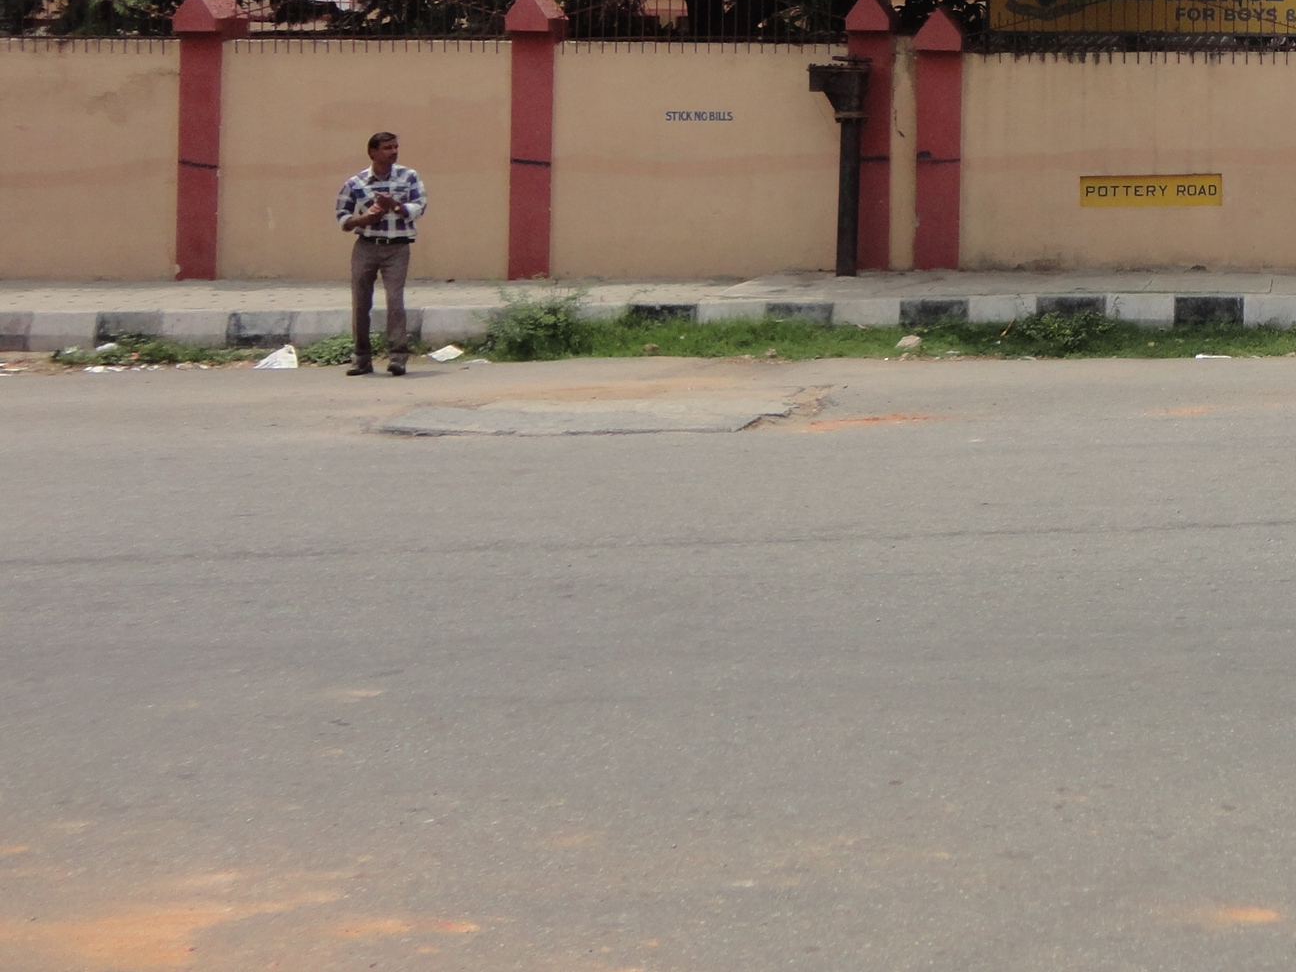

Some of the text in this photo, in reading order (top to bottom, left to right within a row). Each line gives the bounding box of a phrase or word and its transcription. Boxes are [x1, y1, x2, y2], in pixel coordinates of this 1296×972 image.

[1175, 7, 1215, 22] FOR
[1224, 7, 1277, 22] BOYS
[1285, 8, 1296, 22] &
[665, 111, 734, 121] STICK NO BILLS
[1085, 184, 1217, 197] POTTERY ROAD
